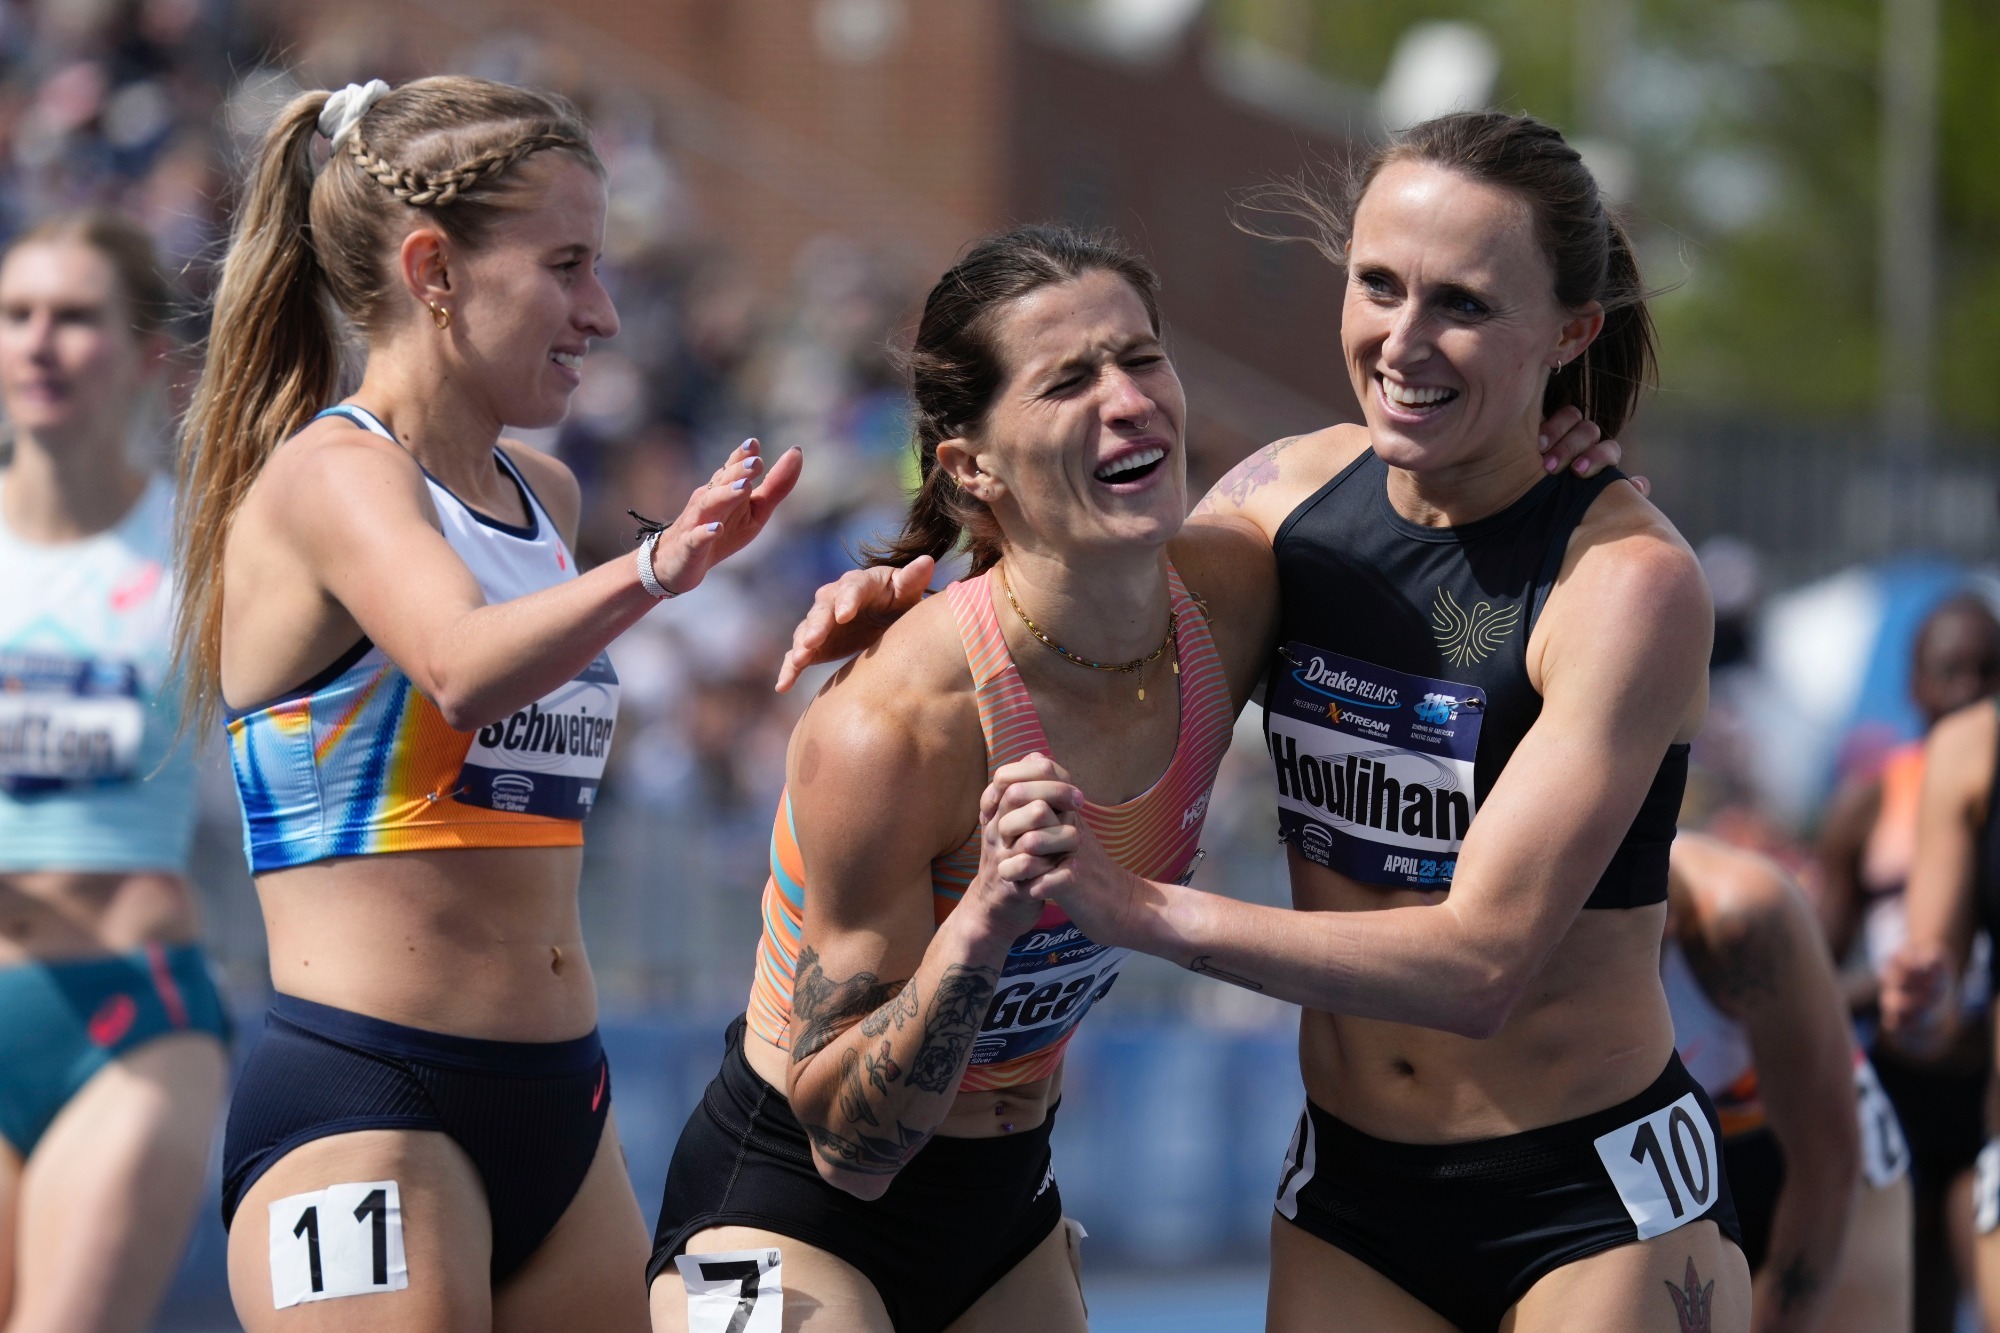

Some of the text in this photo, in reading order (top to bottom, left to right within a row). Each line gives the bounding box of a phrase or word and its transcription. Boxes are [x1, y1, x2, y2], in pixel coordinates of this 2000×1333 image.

[1304, 656, 1398, 705] Drake RELAYS
[478, 703, 613, 758] Schweizer
[1340, 711, 1390, 732] XTREAM
[491, 791, 530, 803] Continental
[1272, 732, 1470, 840] Houlihan
[1383, 855, 1418, 875] APRIL
[1022, 928, 1081, 952] Drake
[980, 974, 1096, 1032] Gea
[1630, 1106, 1709, 1219] 10
[293, 1189, 388, 1293] 11
[698, 1260, 760, 1333] 7
